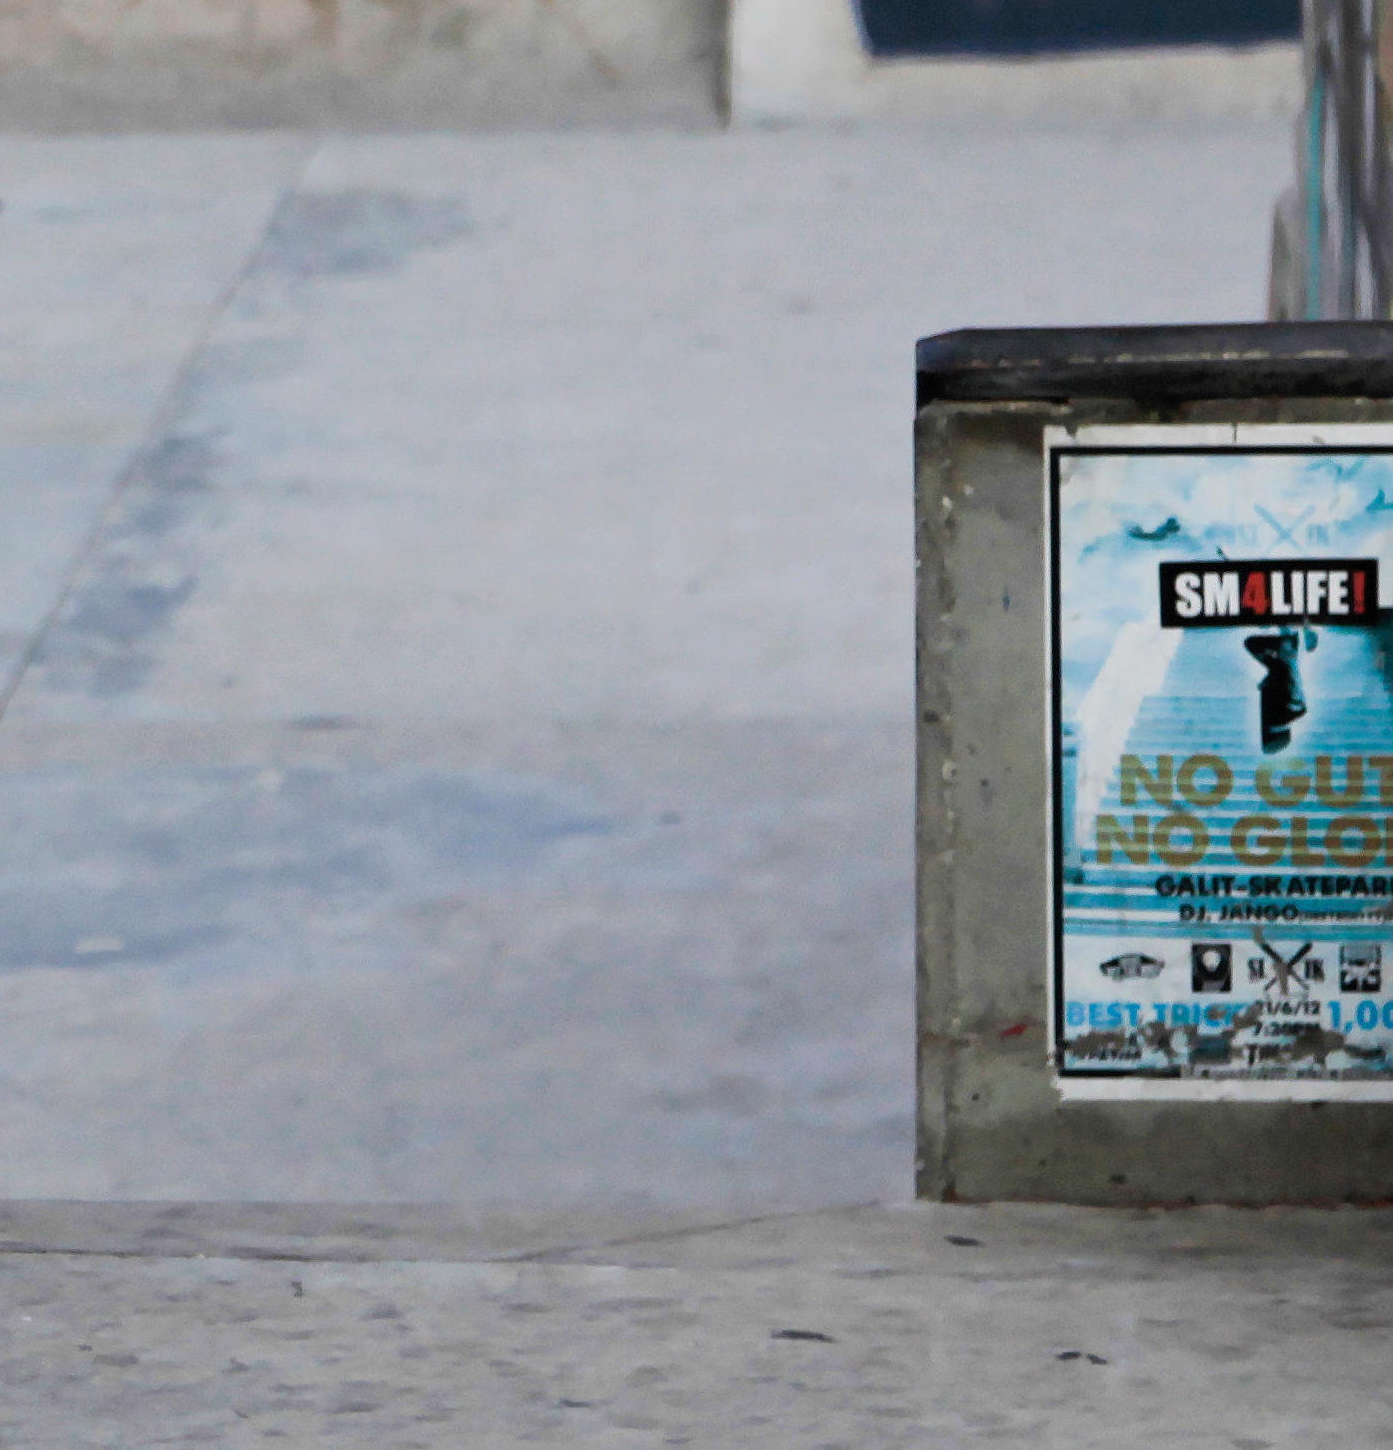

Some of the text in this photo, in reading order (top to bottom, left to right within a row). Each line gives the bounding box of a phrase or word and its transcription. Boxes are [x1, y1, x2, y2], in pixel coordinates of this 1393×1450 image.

[1174, 569, 1367, 618] SM4LIFE!
[1119, 753, 1233, 807] NO
[1096, 813, 1393, 868] NO GLO
[1154, 875, 1393, 897] GALIT-SKATEPAR
[1065, 1001, 1142, 1029] BEST
